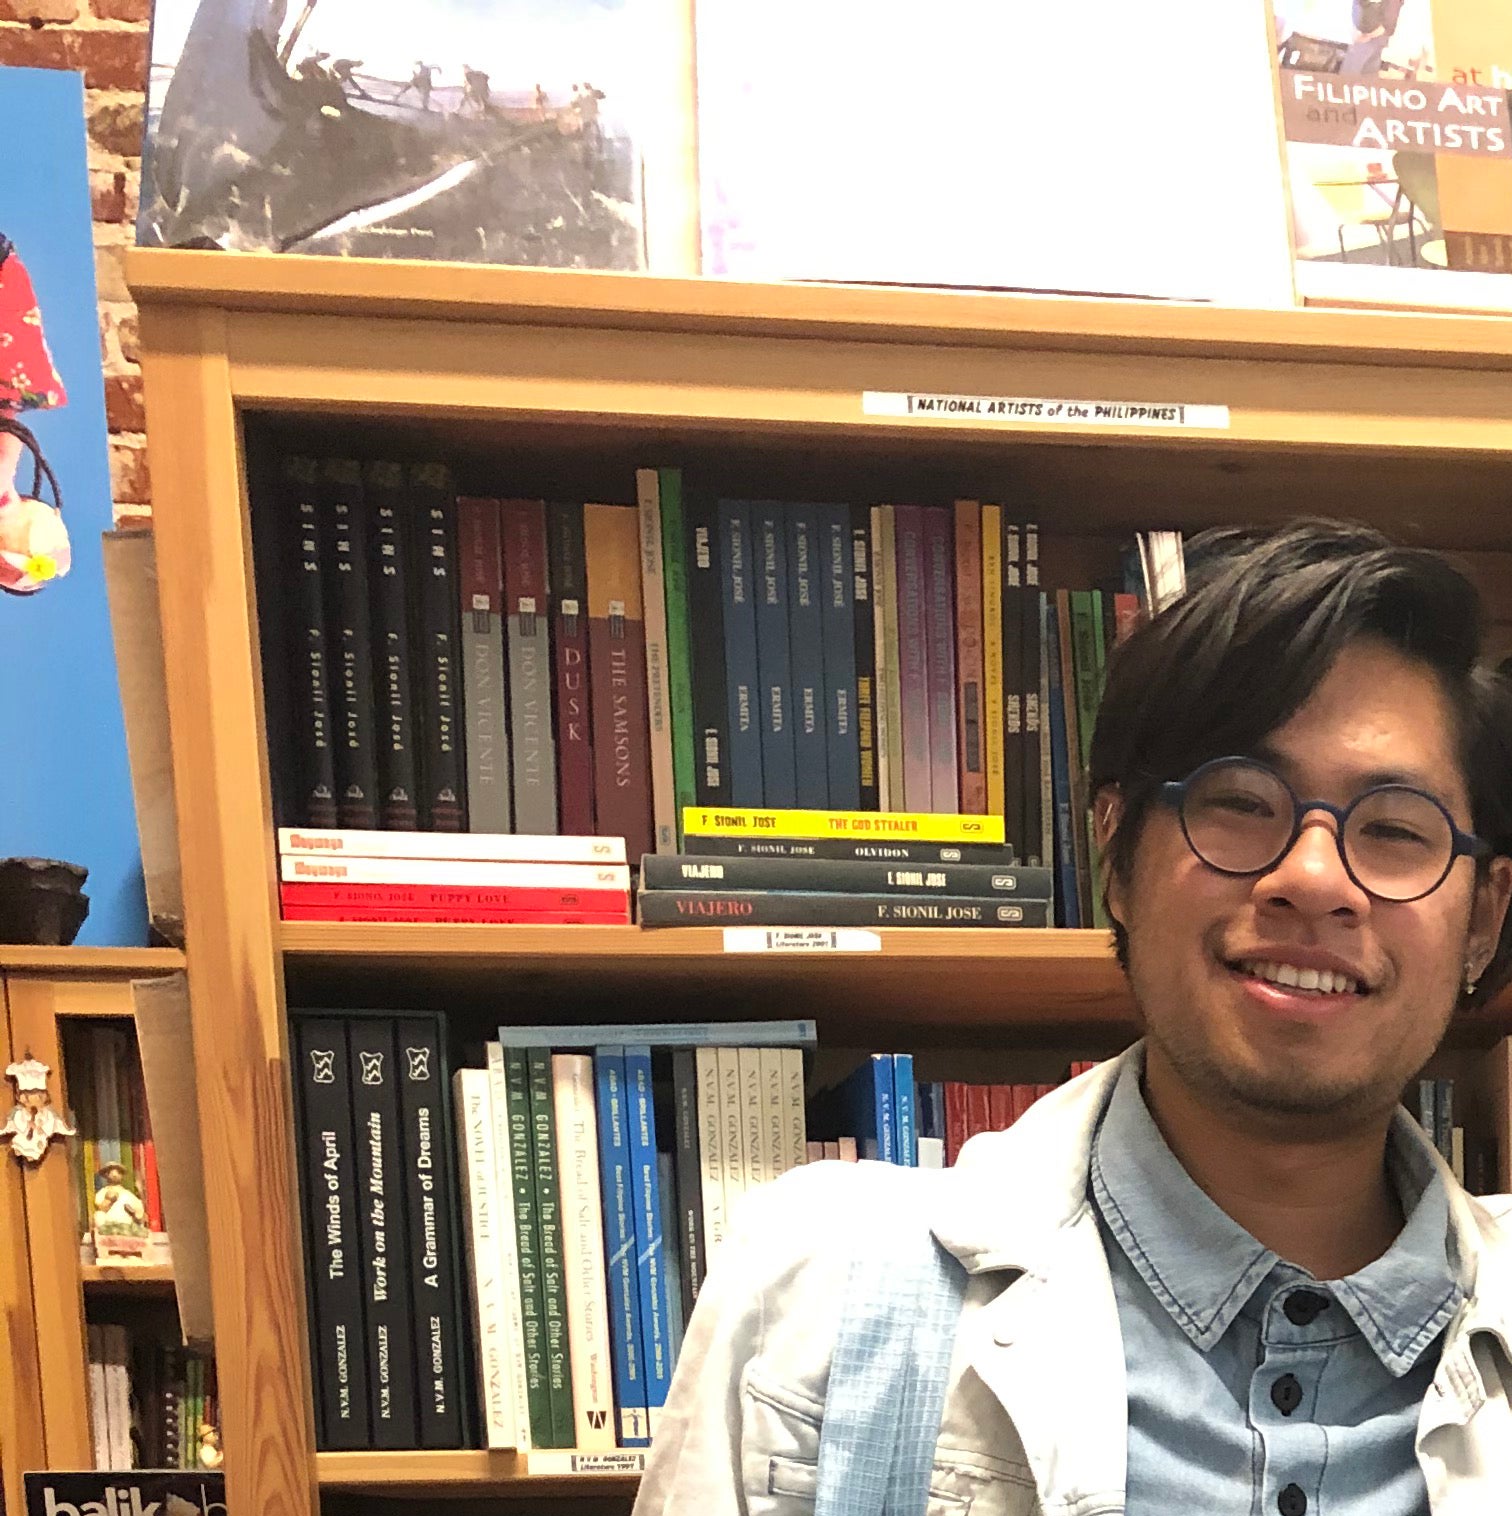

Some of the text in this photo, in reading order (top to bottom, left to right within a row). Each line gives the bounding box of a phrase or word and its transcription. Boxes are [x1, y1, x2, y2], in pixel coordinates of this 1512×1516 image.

[1294, 74, 1503, 117] FILIPINO ART
[1452, 67, 1482, 88] at
[1306, 104, 1357, 127] and
[1353, 118, 1505, 153] ARTISTS
[917, 398, 1176, 421] NATIONAL ARTISTS of the PHILIPPINES
[300, 504, 319, 573] SINS
[336, 504, 352, 573] SINS
[380, 508, 398, 577] SINS
[430, 509, 446, 578] SINS
[474, 643, 494, 786] DON VICENTE
[521, 646, 541, 788] DON VICENTE
[565, 647, 583, 742] DUSK
[612, 649, 633, 788] THE SAMSONS
[738, 686, 750, 732] ERMITA
[771, 686, 782, 733] ERMITA
[803, 688, 815, 735] ERMITA
[836, 689, 848, 735] ERMITA
[714, 816, 748, 828] SIONIL
[828, 818, 919, 832] THE GOD STEALER
[476, 894, 512, 904] LOVE
[676, 900, 754, 916] VIAJERO
[878, 904, 982, 920] F. SIONIL JOSE
[322, 1131, 345, 1280] The Winds of April
[367, 1112, 388, 1302] Work on the Mountain
[417, 1107, 440, 1288] A Grammar of Dreams
[511, 1114, 541, 1389] GONZALEZ The Bread of Salt and Other Stories
[535, 1114, 566, 1389] GONZALEZ The Bread of Salt and Other Stories
[336, 1325, 349, 1383] GONZALEZ
[378, 1325, 390, 1382] GONZALEZ
[430, 1316, 445, 1413] N.V.M. GONZALEZ
